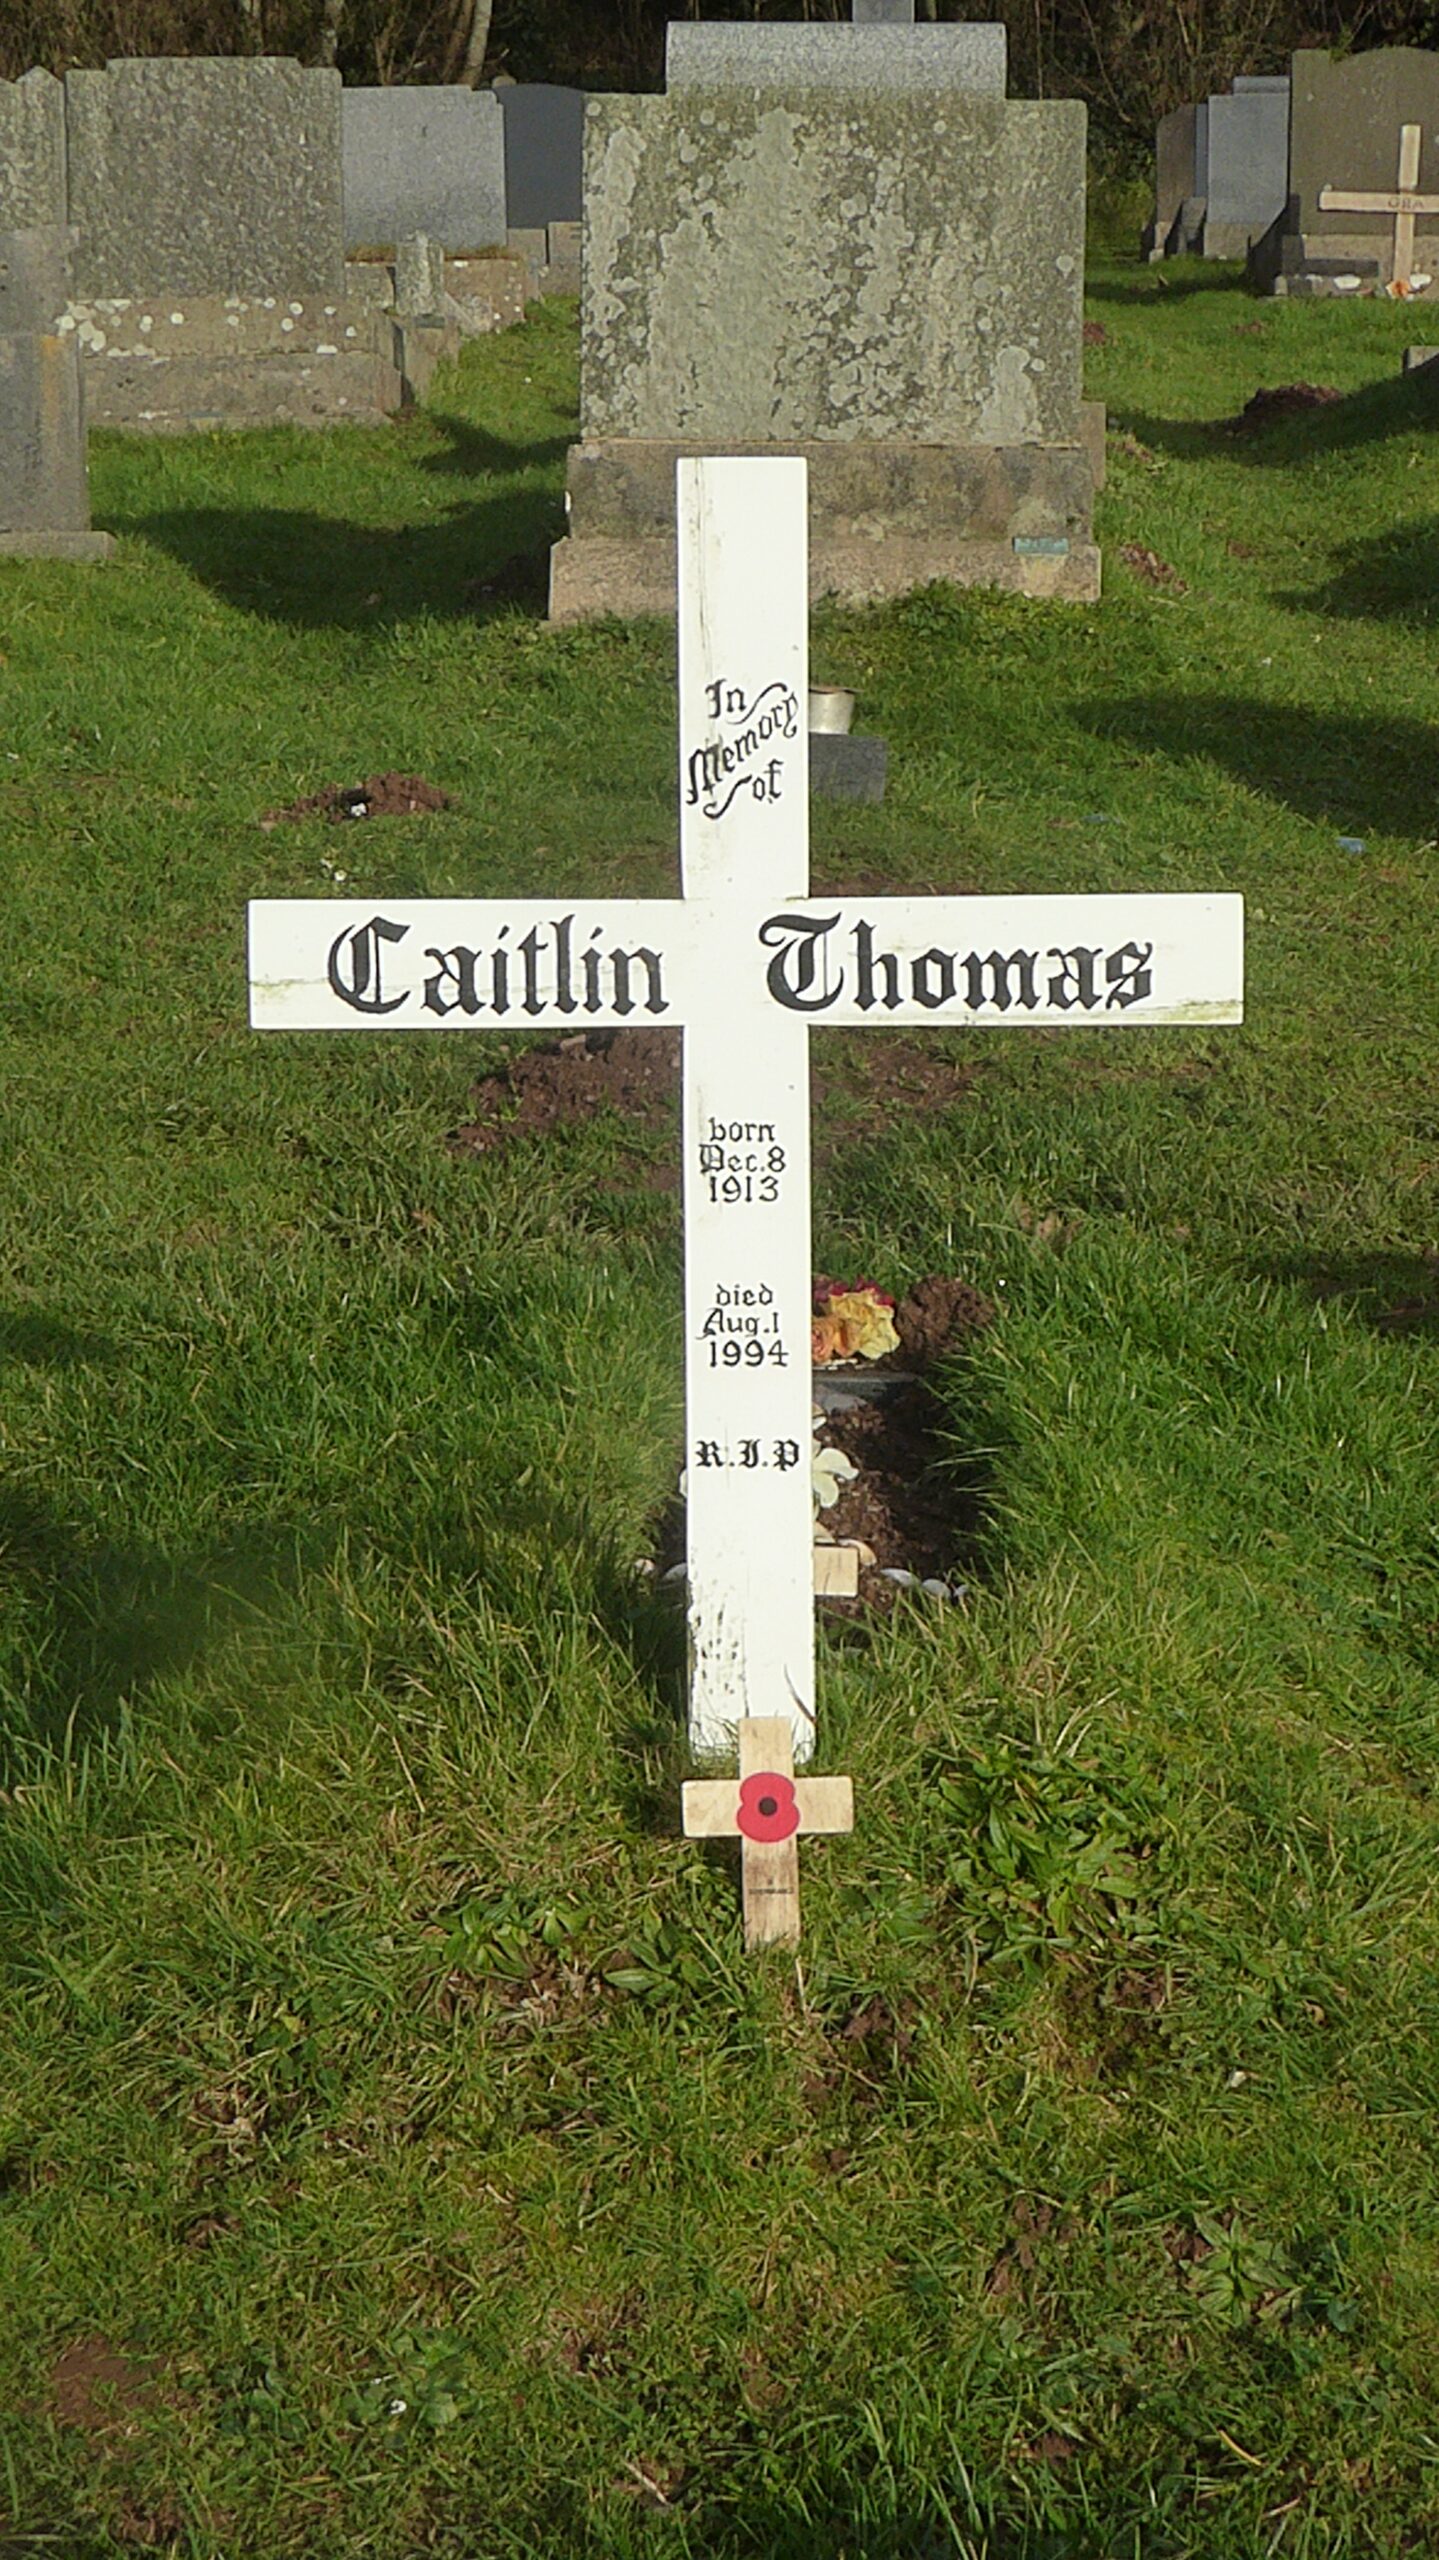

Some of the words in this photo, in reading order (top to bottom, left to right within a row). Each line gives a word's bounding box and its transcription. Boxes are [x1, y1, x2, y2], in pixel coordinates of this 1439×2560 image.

[704, 678, 746, 719] In
[686, 691, 799, 805] Memory
[752, 758, 784, 804] of
[327, 914, 671, 1017] Caitlin
[758, 912, 1153, 1012] Thomas
[708, 1117, 777, 1143] born
[708, 1175, 779, 1203] 1913
[715, 1284, 774, 1307] died
[709, 1339, 789, 1368] 1994
[695, 1440, 800, 1472] R.I.P
